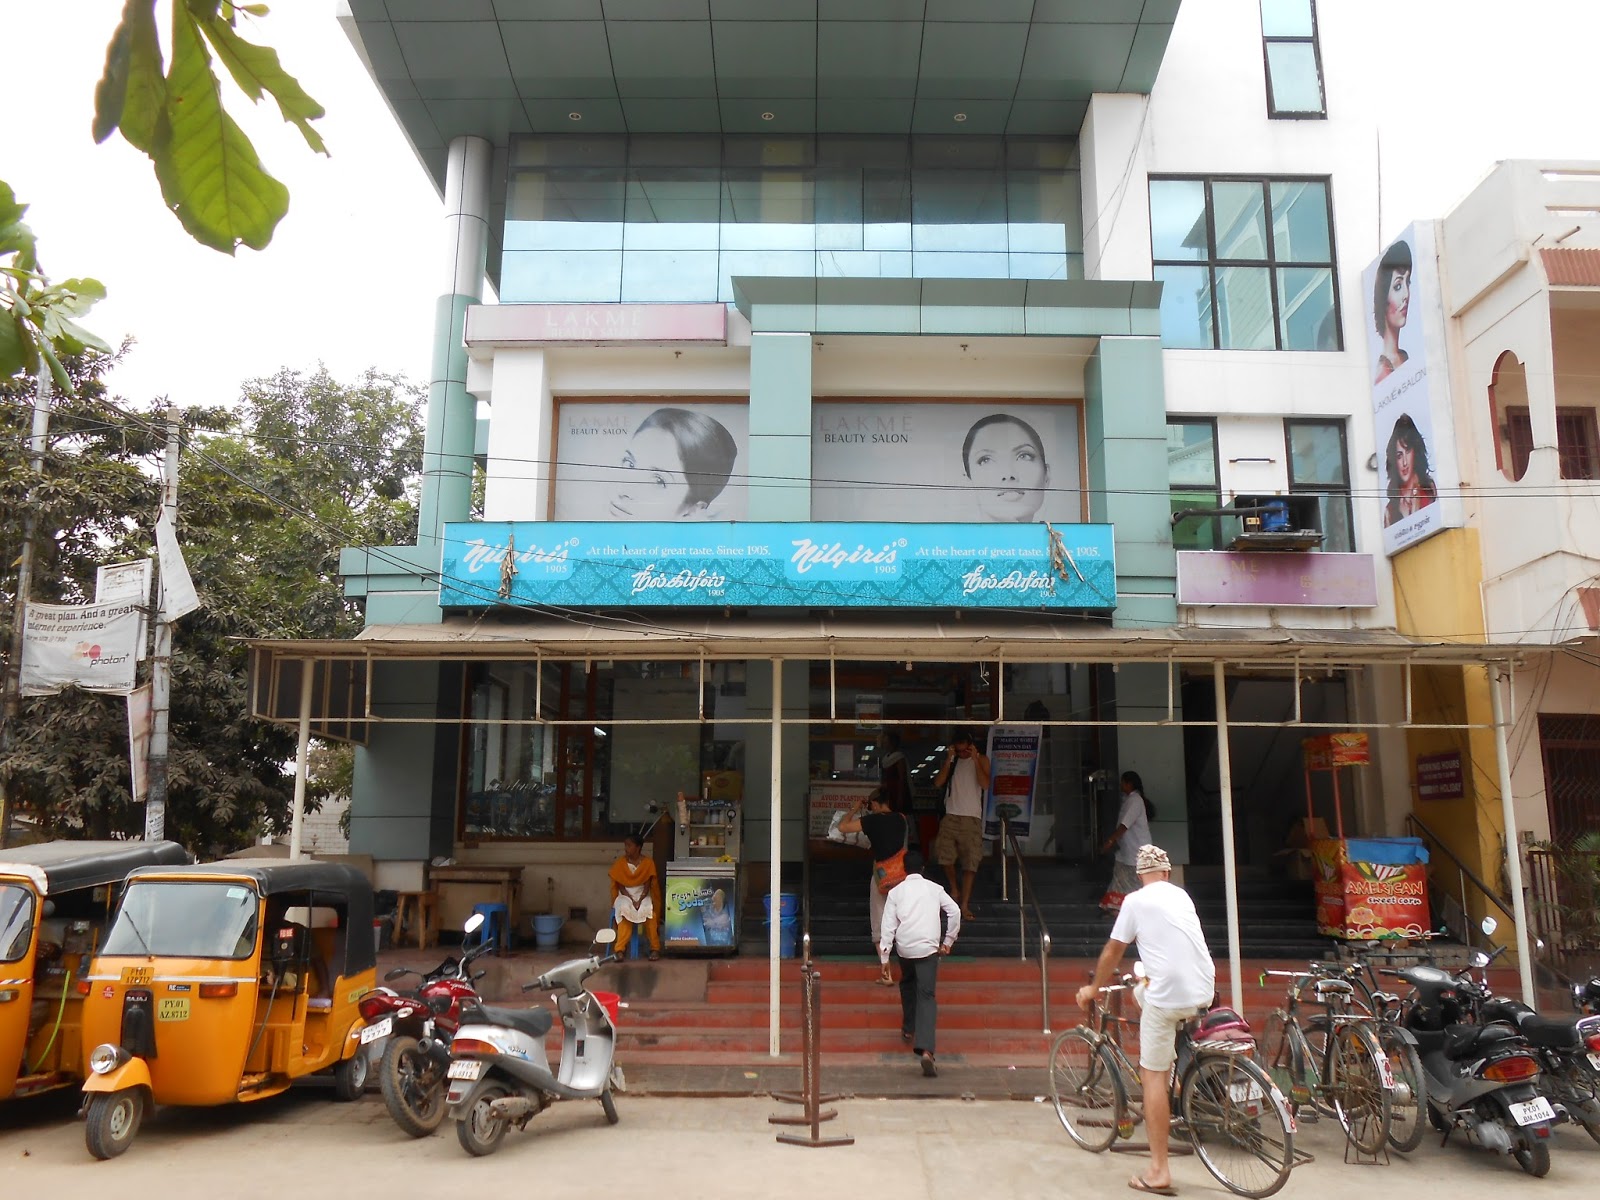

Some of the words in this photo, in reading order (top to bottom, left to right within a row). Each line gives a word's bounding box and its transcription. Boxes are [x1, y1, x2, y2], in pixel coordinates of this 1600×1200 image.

[824, 433, 866, 443] BEAUTY
[871, 433, 909, 443] SALON
[586, 545, 601, 556] At
[602, 545, 619, 556] the
[621, 545, 647, 556] heart
[648, 545, 659, 556] of
[660, 546, 687, 557] great
[689, 546, 715, 556] taste.
[716, 545, 744, 556] Since
[746, 545, 772, 556] 1905.
[915, 546, 929, 557] At
[931, 545, 948, 557] the
[950, 546, 976, 557] heart
[977, 546, 989, 557] of
[990, 547, 1016, 558] great
[1018, 547, 1045, 557] taste.
[1076, 546, 1101, 557] 1905.
[545, 564, 568, 574] 1905
[874, 565, 897, 574] 1905
[707, 589, 725, 597] 1905
[1039, 590, 1057, 598] 1905
[28, 609, 34, 618] A
[35, 611, 57, 621] great
[58, 610, 79, 622] plan.
[80, 609, 98, 620] And
[100, 610, 106, 618] a
[108, 605, 134, 619] great
[820, 794, 839, 802] AVOID
[677, 898, 705, 912] Soda
[1367, 896, 1397, 904] sweet
[1398, 897, 1422, 905] corn
